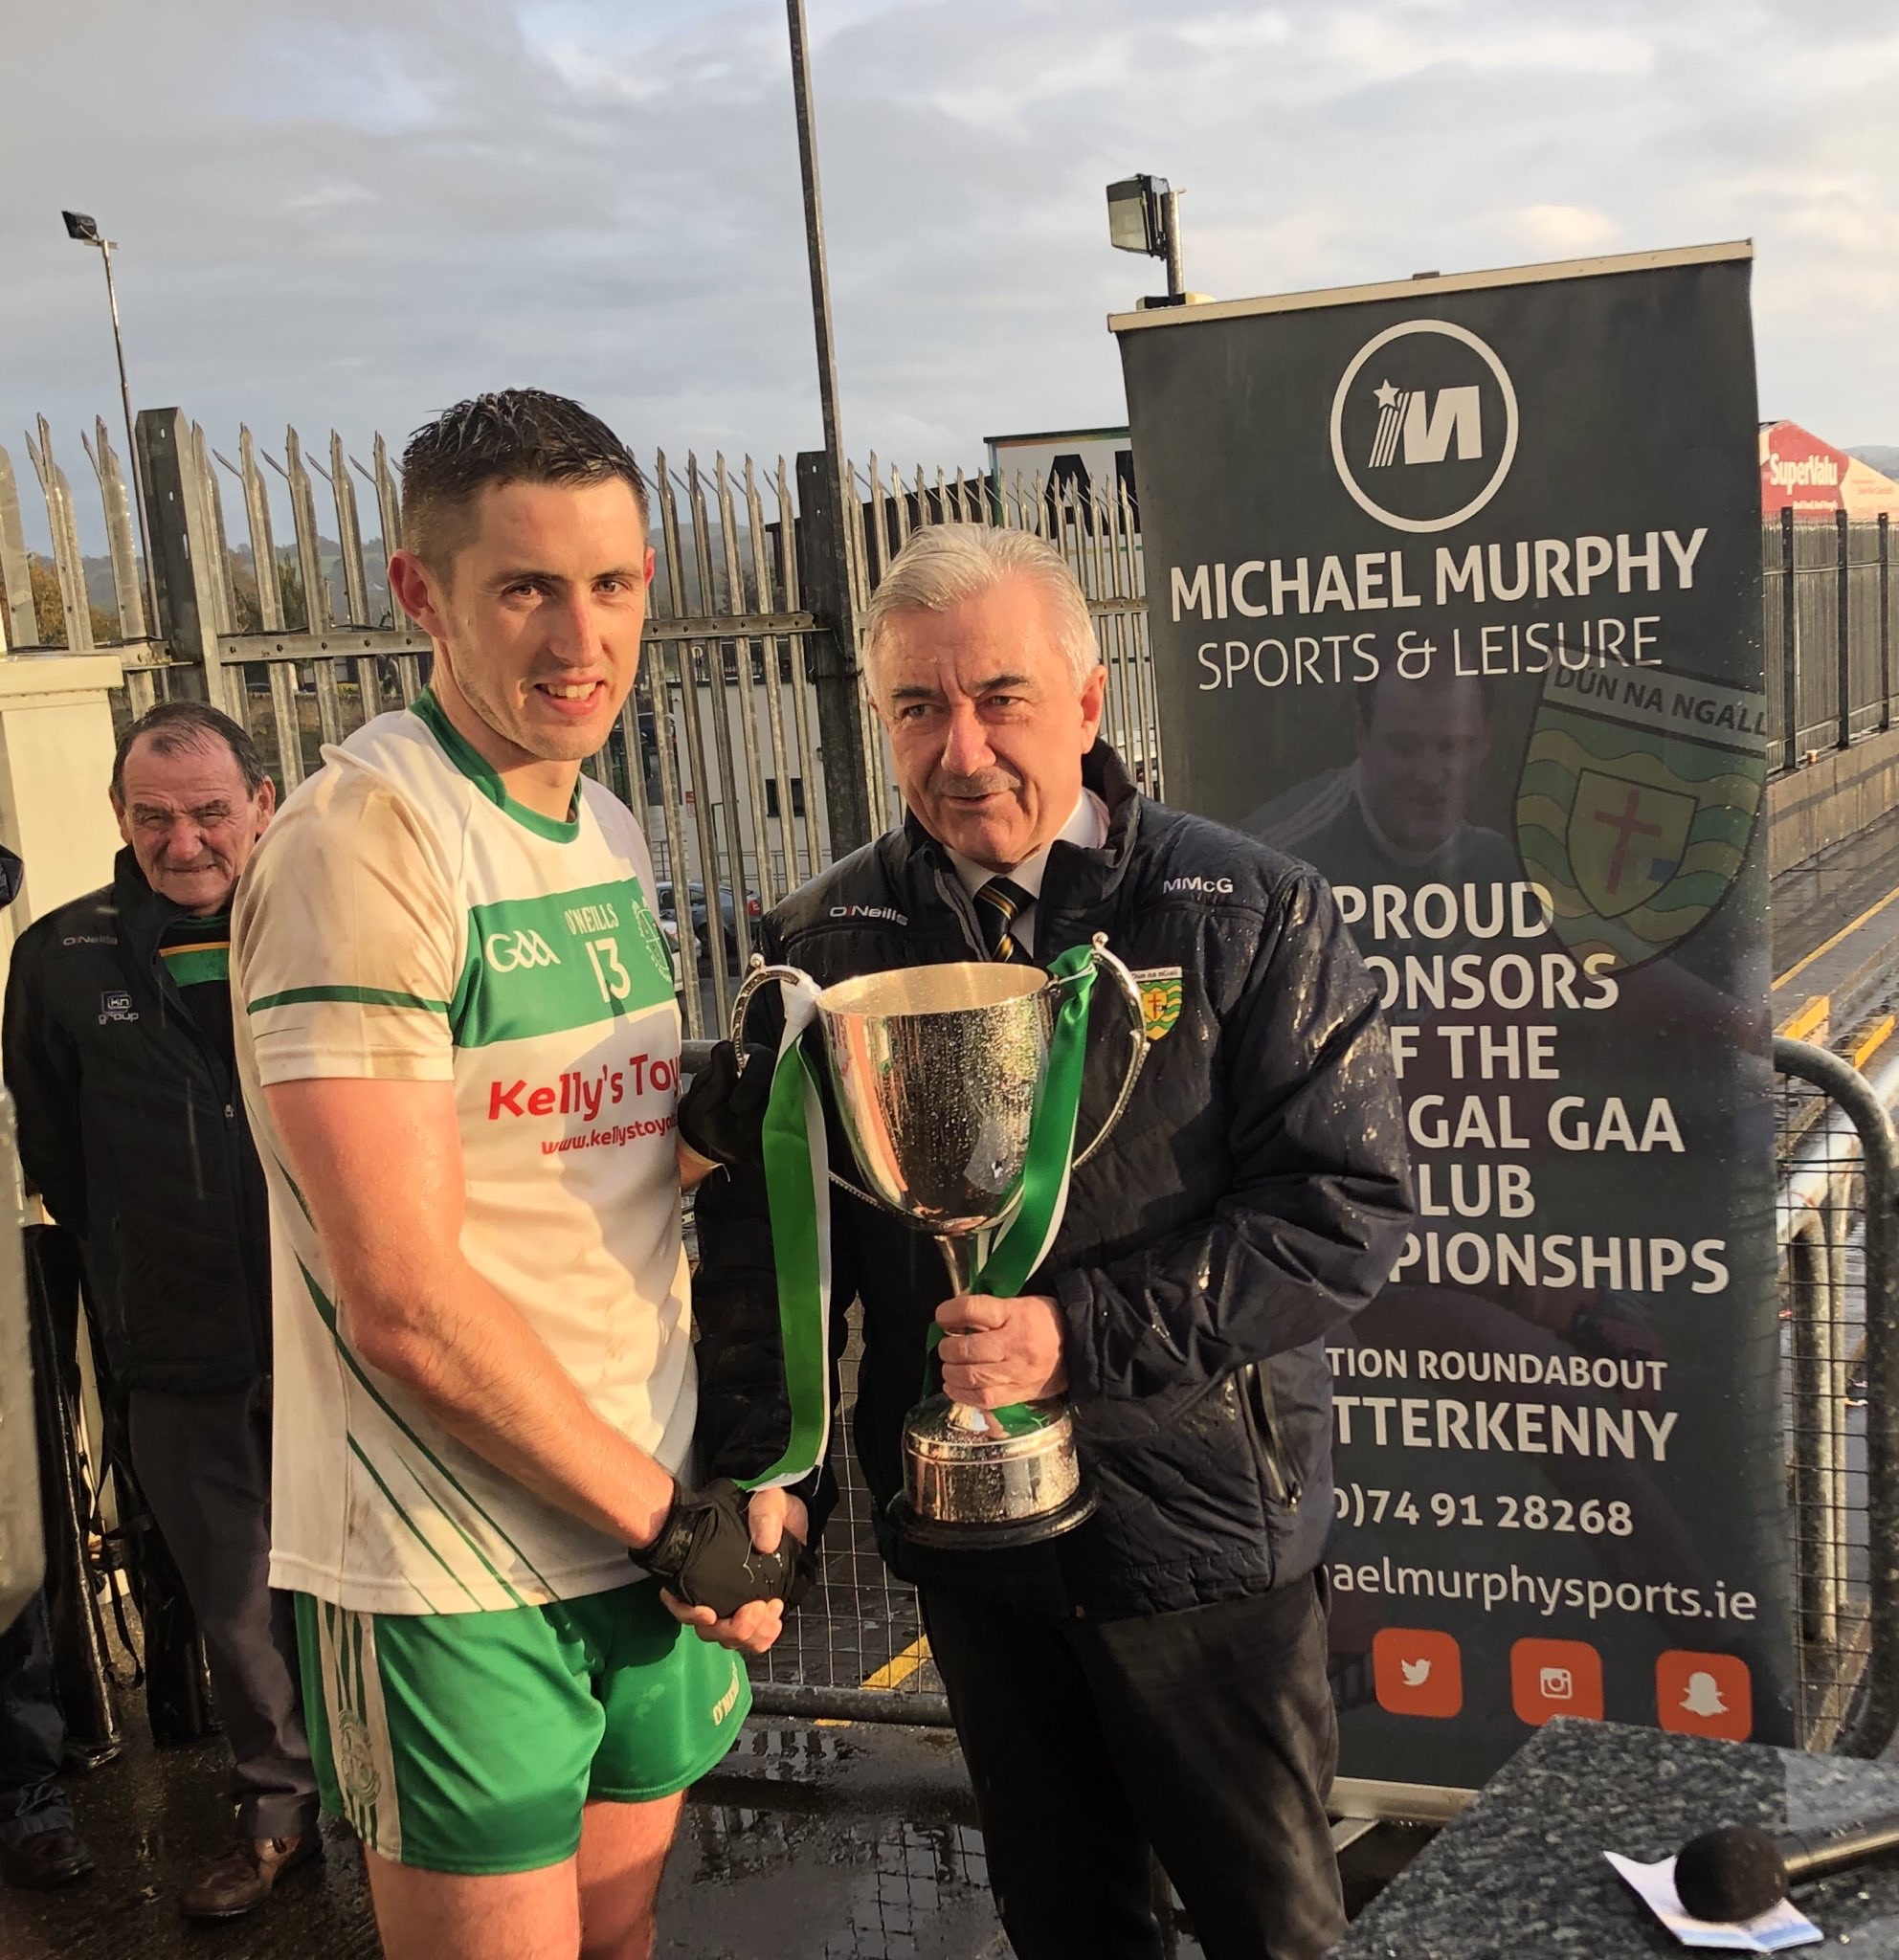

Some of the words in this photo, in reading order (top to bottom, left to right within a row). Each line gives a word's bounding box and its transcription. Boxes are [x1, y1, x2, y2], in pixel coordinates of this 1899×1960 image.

[1769, 453, 1838, 496] SuperValu
[1170, 550, 1422, 623] MICHAEL
[1436, 527, 1709, 607] MURPHY
[1197, 633, 1380, 691] SPORTS
[1396, 631, 1438, 679] &
[1453, 615, 1664, 677] LEISURE
[1623, 681, 1664, 714] NA
[1672, 693, 1767, 737] NGALL
[1163, 876, 1234, 894] MMcG
[1331, 881, 1555, 940] PROUD
[564, 902, 620, 935] O'NEILLS
[585, 937, 632, 1004] 13
[1363, 953, 1620, 1012] ONSORS
[99, 1013, 139, 1025] group
[1389, 1025, 1421, 1080] F
[1437, 1025, 1561, 1080] THE
[488, 1064, 624, 1122] Kelly's
[629, 1054, 681, 1098] Toy
[1407, 1095, 1530, 1151] GAL
[1546, 1097, 1687, 1154] GAA
[1417, 1163, 1536, 1219] LUB
[1389, 1231, 1731, 1295] PIONSHIPS
[1325, 1347, 1408, 1379] TION
[1418, 1349, 1668, 1392] ROUNDABOUT
[1331, 1394, 1679, 1462] TTERKENNY
[1332, 1482, 1420, 1528] 0)74
[1430, 1492, 1484, 1528] 91
[1495, 1494, 1634, 1537] 28268
[1325, 1554, 1758, 1621] aelmurphysports.ie
